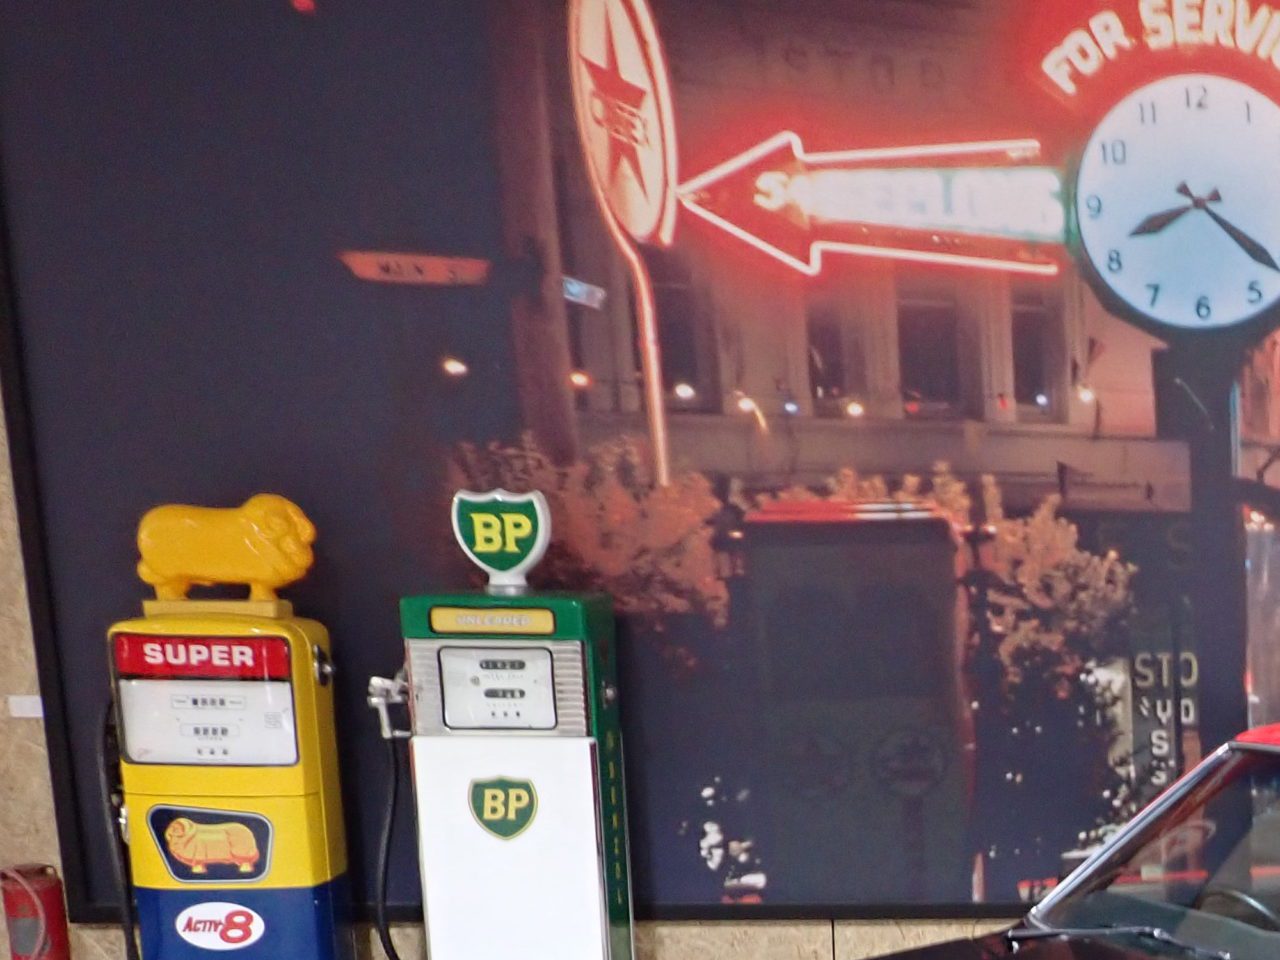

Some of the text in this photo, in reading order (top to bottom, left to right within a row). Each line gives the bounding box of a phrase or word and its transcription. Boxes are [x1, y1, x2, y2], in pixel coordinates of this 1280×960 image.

[1041, 10, 1134, 96] FOR
[1185, 86, 1208, 111] 12
[1138, 101, 1157, 125] 11
[1101, 139, 1127, 165] 10
[1086, 194, 1103, 219] 9
[1107, 248, 1122, 273] 8
[1146, 283, 1160, 308] 7
[1247, 279, 1263, 304] 5
[1195, 295, 1212, 320] 6
[470, 512, 533, 554] BP
[143, 642, 255, 668] SUPER
[482, 787, 530, 822] BP
